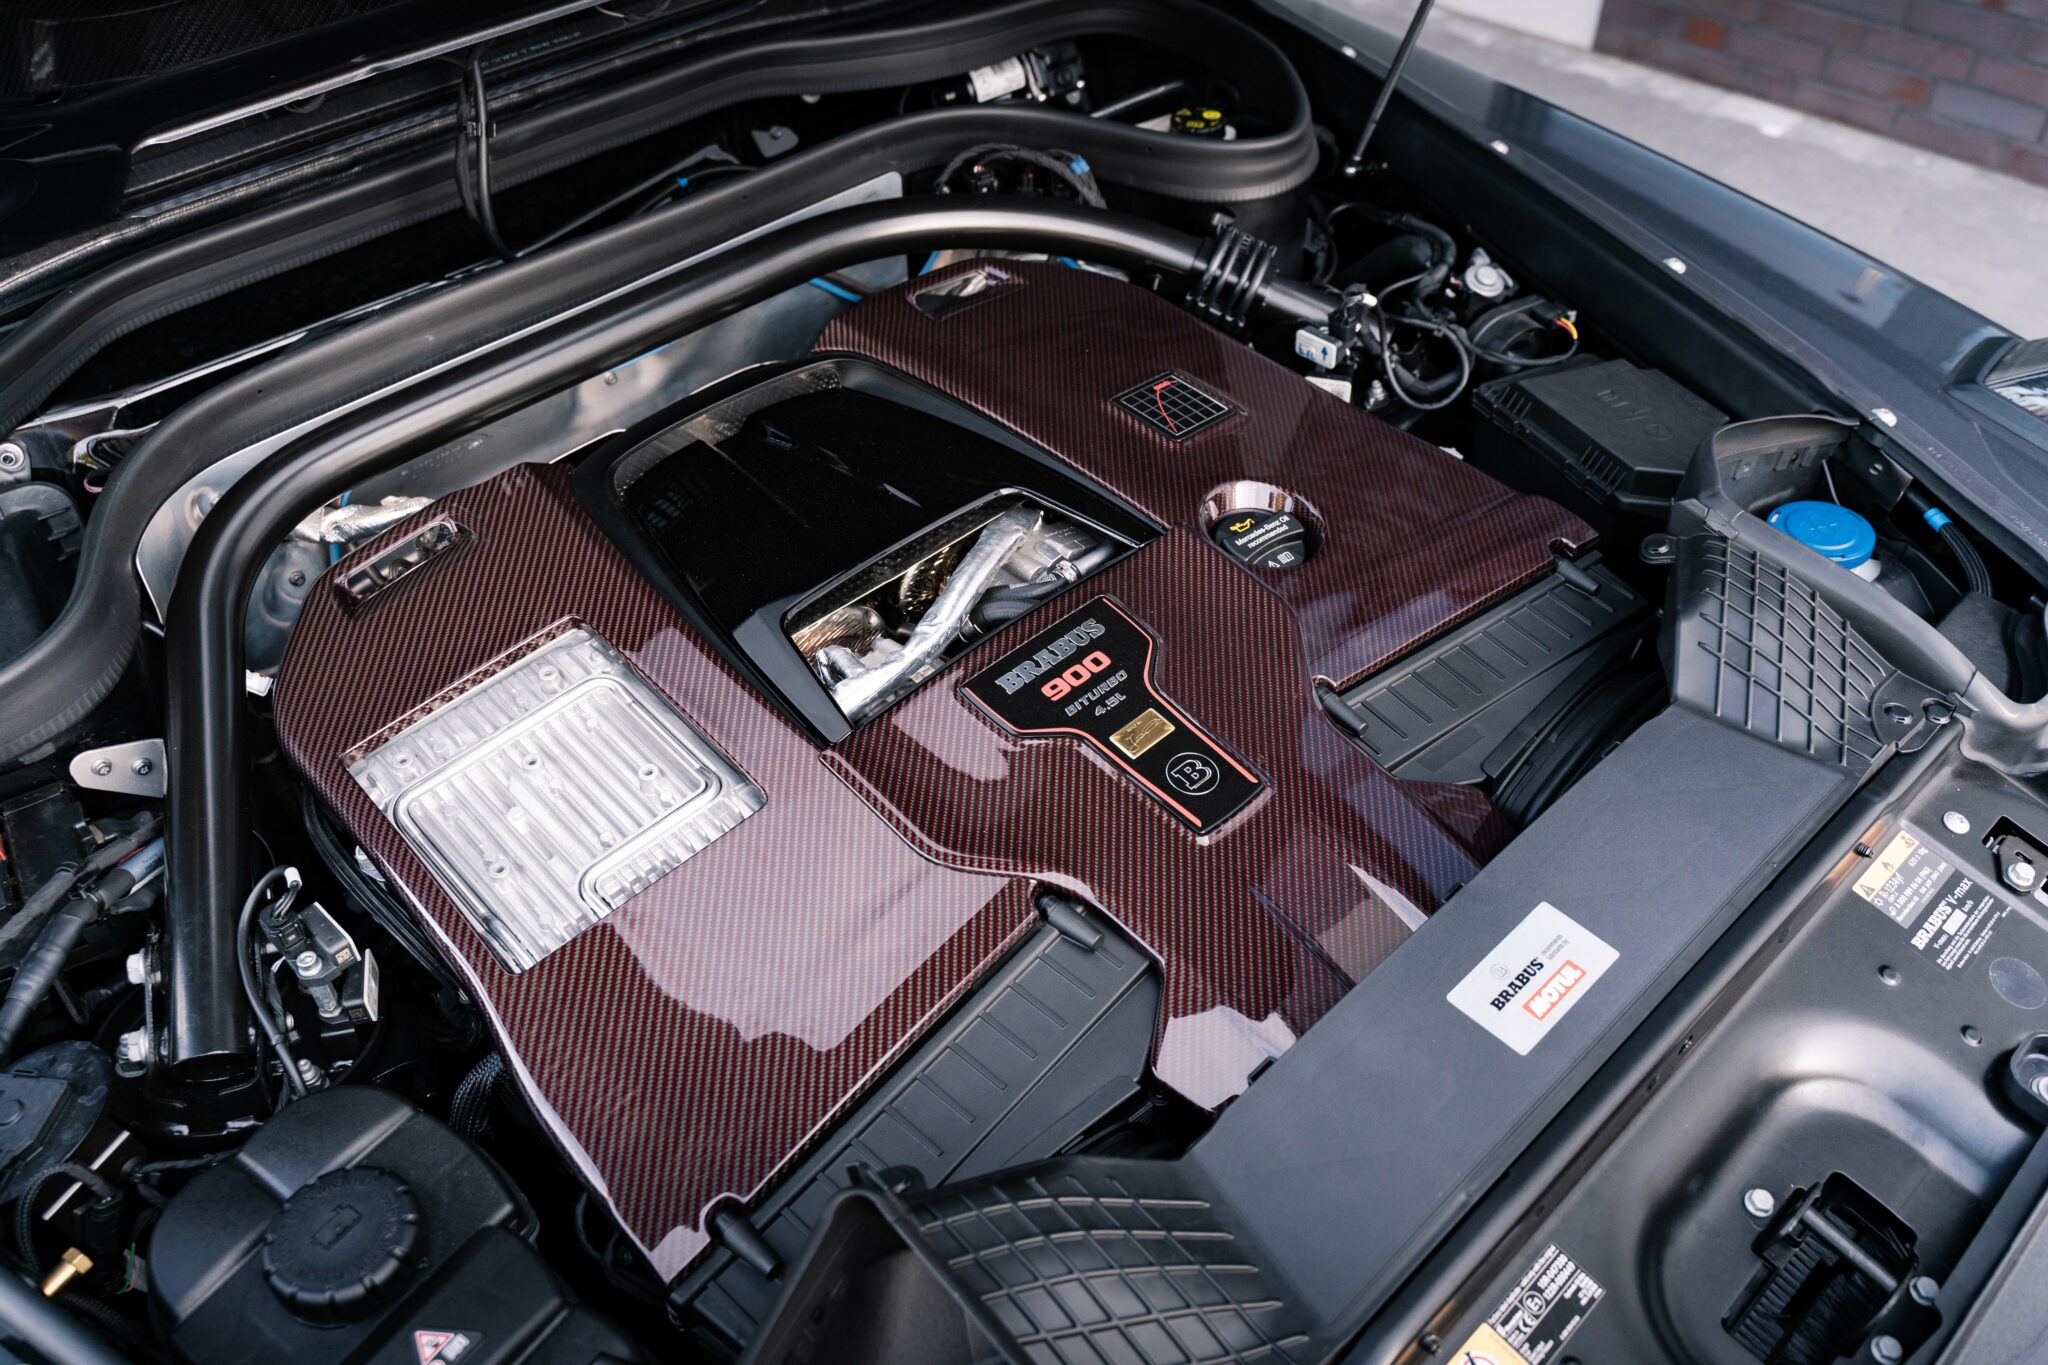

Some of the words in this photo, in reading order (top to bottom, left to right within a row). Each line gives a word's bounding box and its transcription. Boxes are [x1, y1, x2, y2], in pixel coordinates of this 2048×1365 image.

[1234, 518, 1281, 546] Mercedes-Benz
[1279, 515, 1290, 523] Oil
[1247, 524, 1289, 549] recommended
[995, 618, 1105, 695] BRABUS
[1040, 650, 1112, 701] 900
[1064, 669, 1128, 717] BITURBO
[1093, 692, 1127, 717] 4.5L
[1170, 758, 1213, 791] B
[1910, 901, 1952, 950] BRABUS
[1946, 877, 1973, 906] V-max
[1489, 958, 1545, 1012] BRABUS
[1528, 964, 1583, 1017] MOTUL
